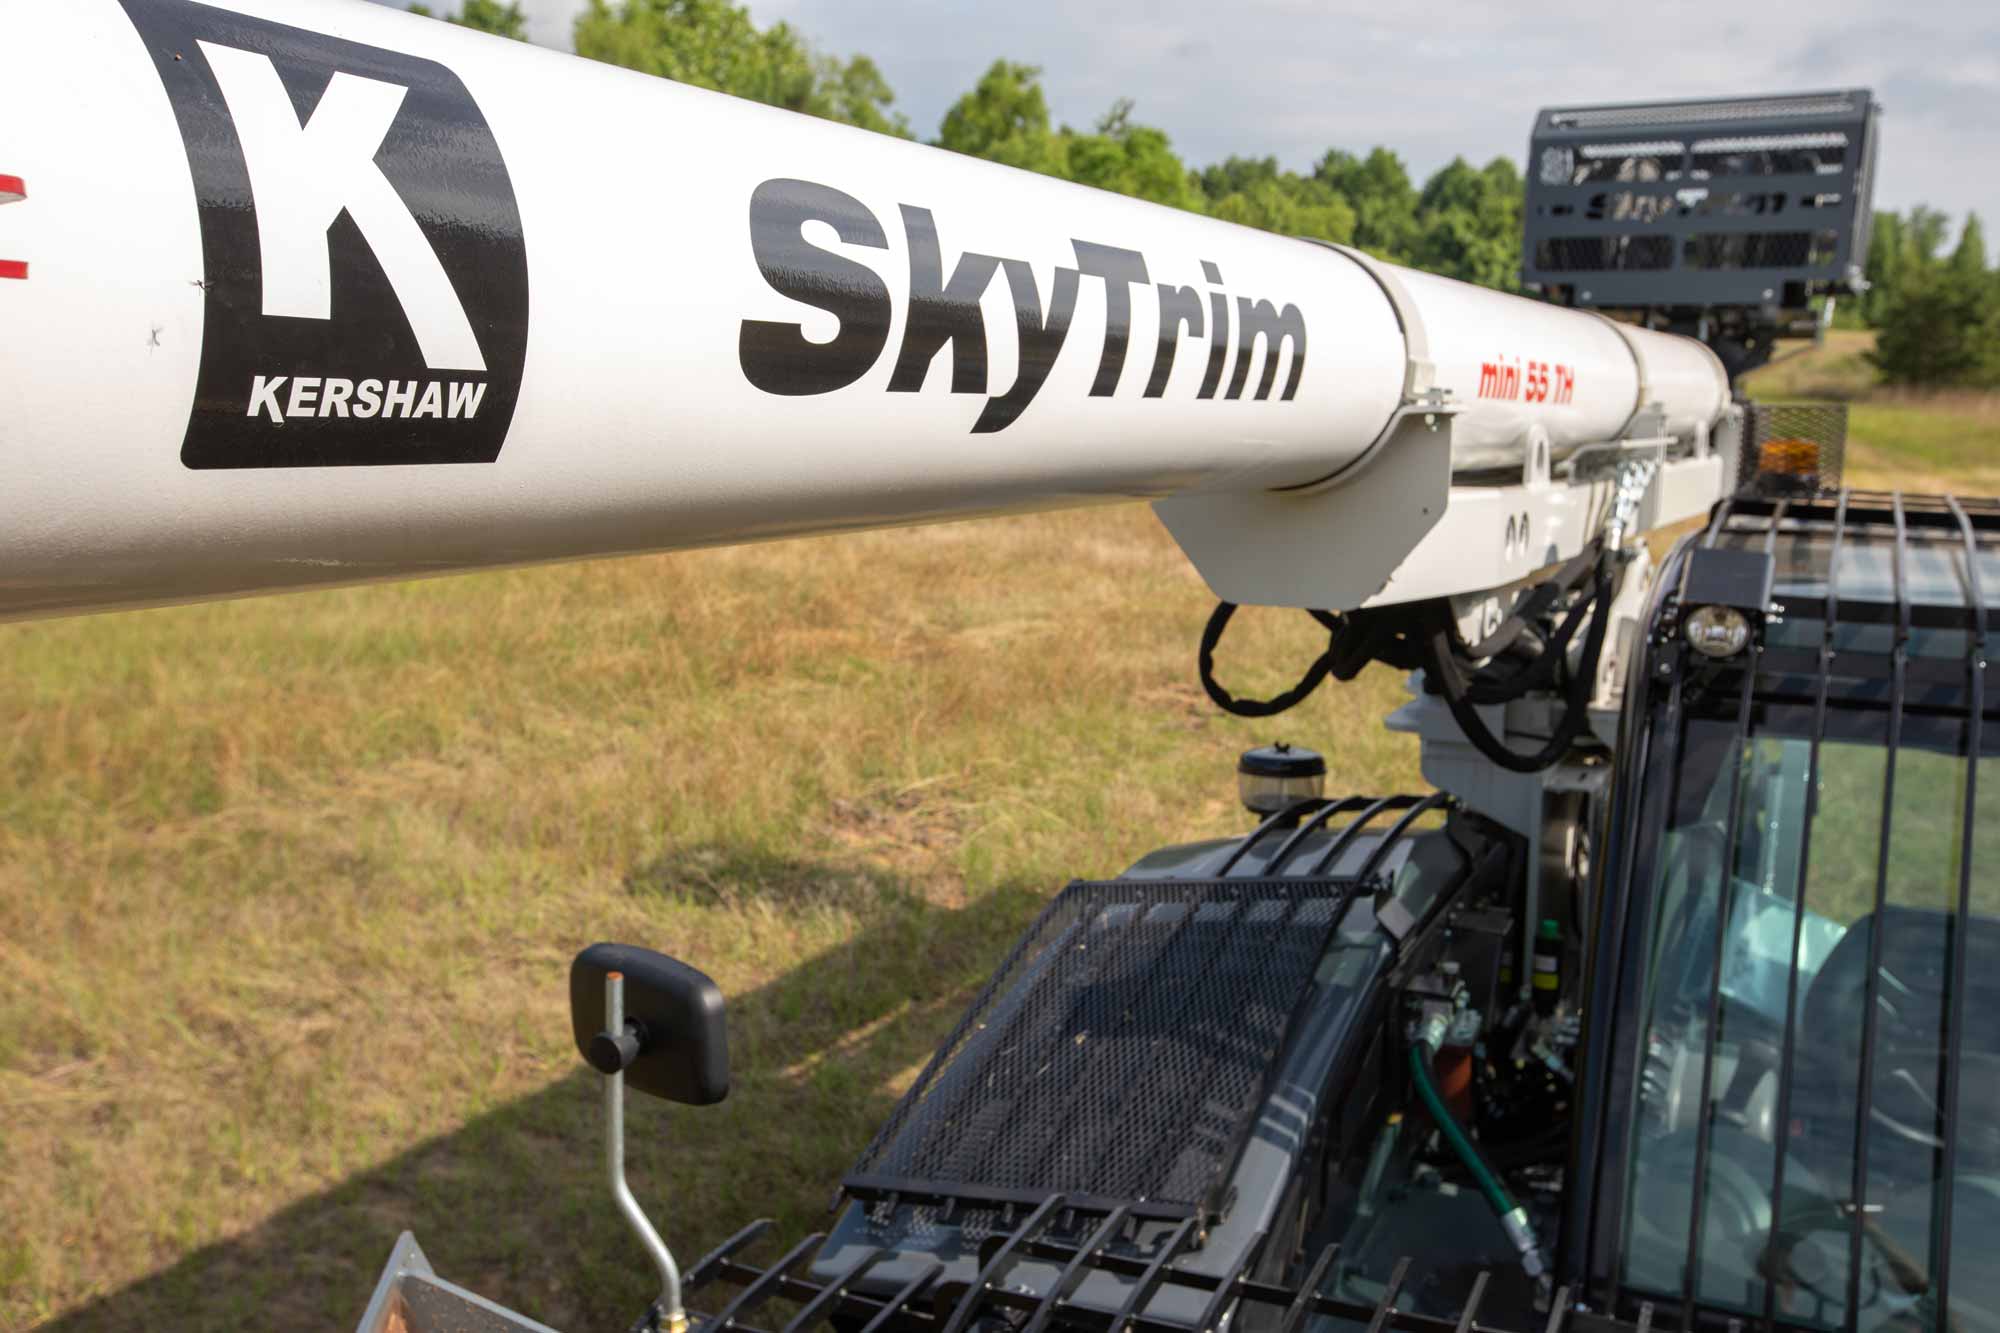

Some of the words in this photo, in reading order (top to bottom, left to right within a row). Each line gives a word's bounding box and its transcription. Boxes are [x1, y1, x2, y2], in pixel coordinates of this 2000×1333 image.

[196, 39, 487, 371] K
[739, 178, 1307, 434] SkyTrim
[1479, 353, 1521, 400] mini
[1525, 361, 1549, 403] 55
[1553, 364, 1575, 404] TH
[247, 376, 488, 422] KERSHAW
